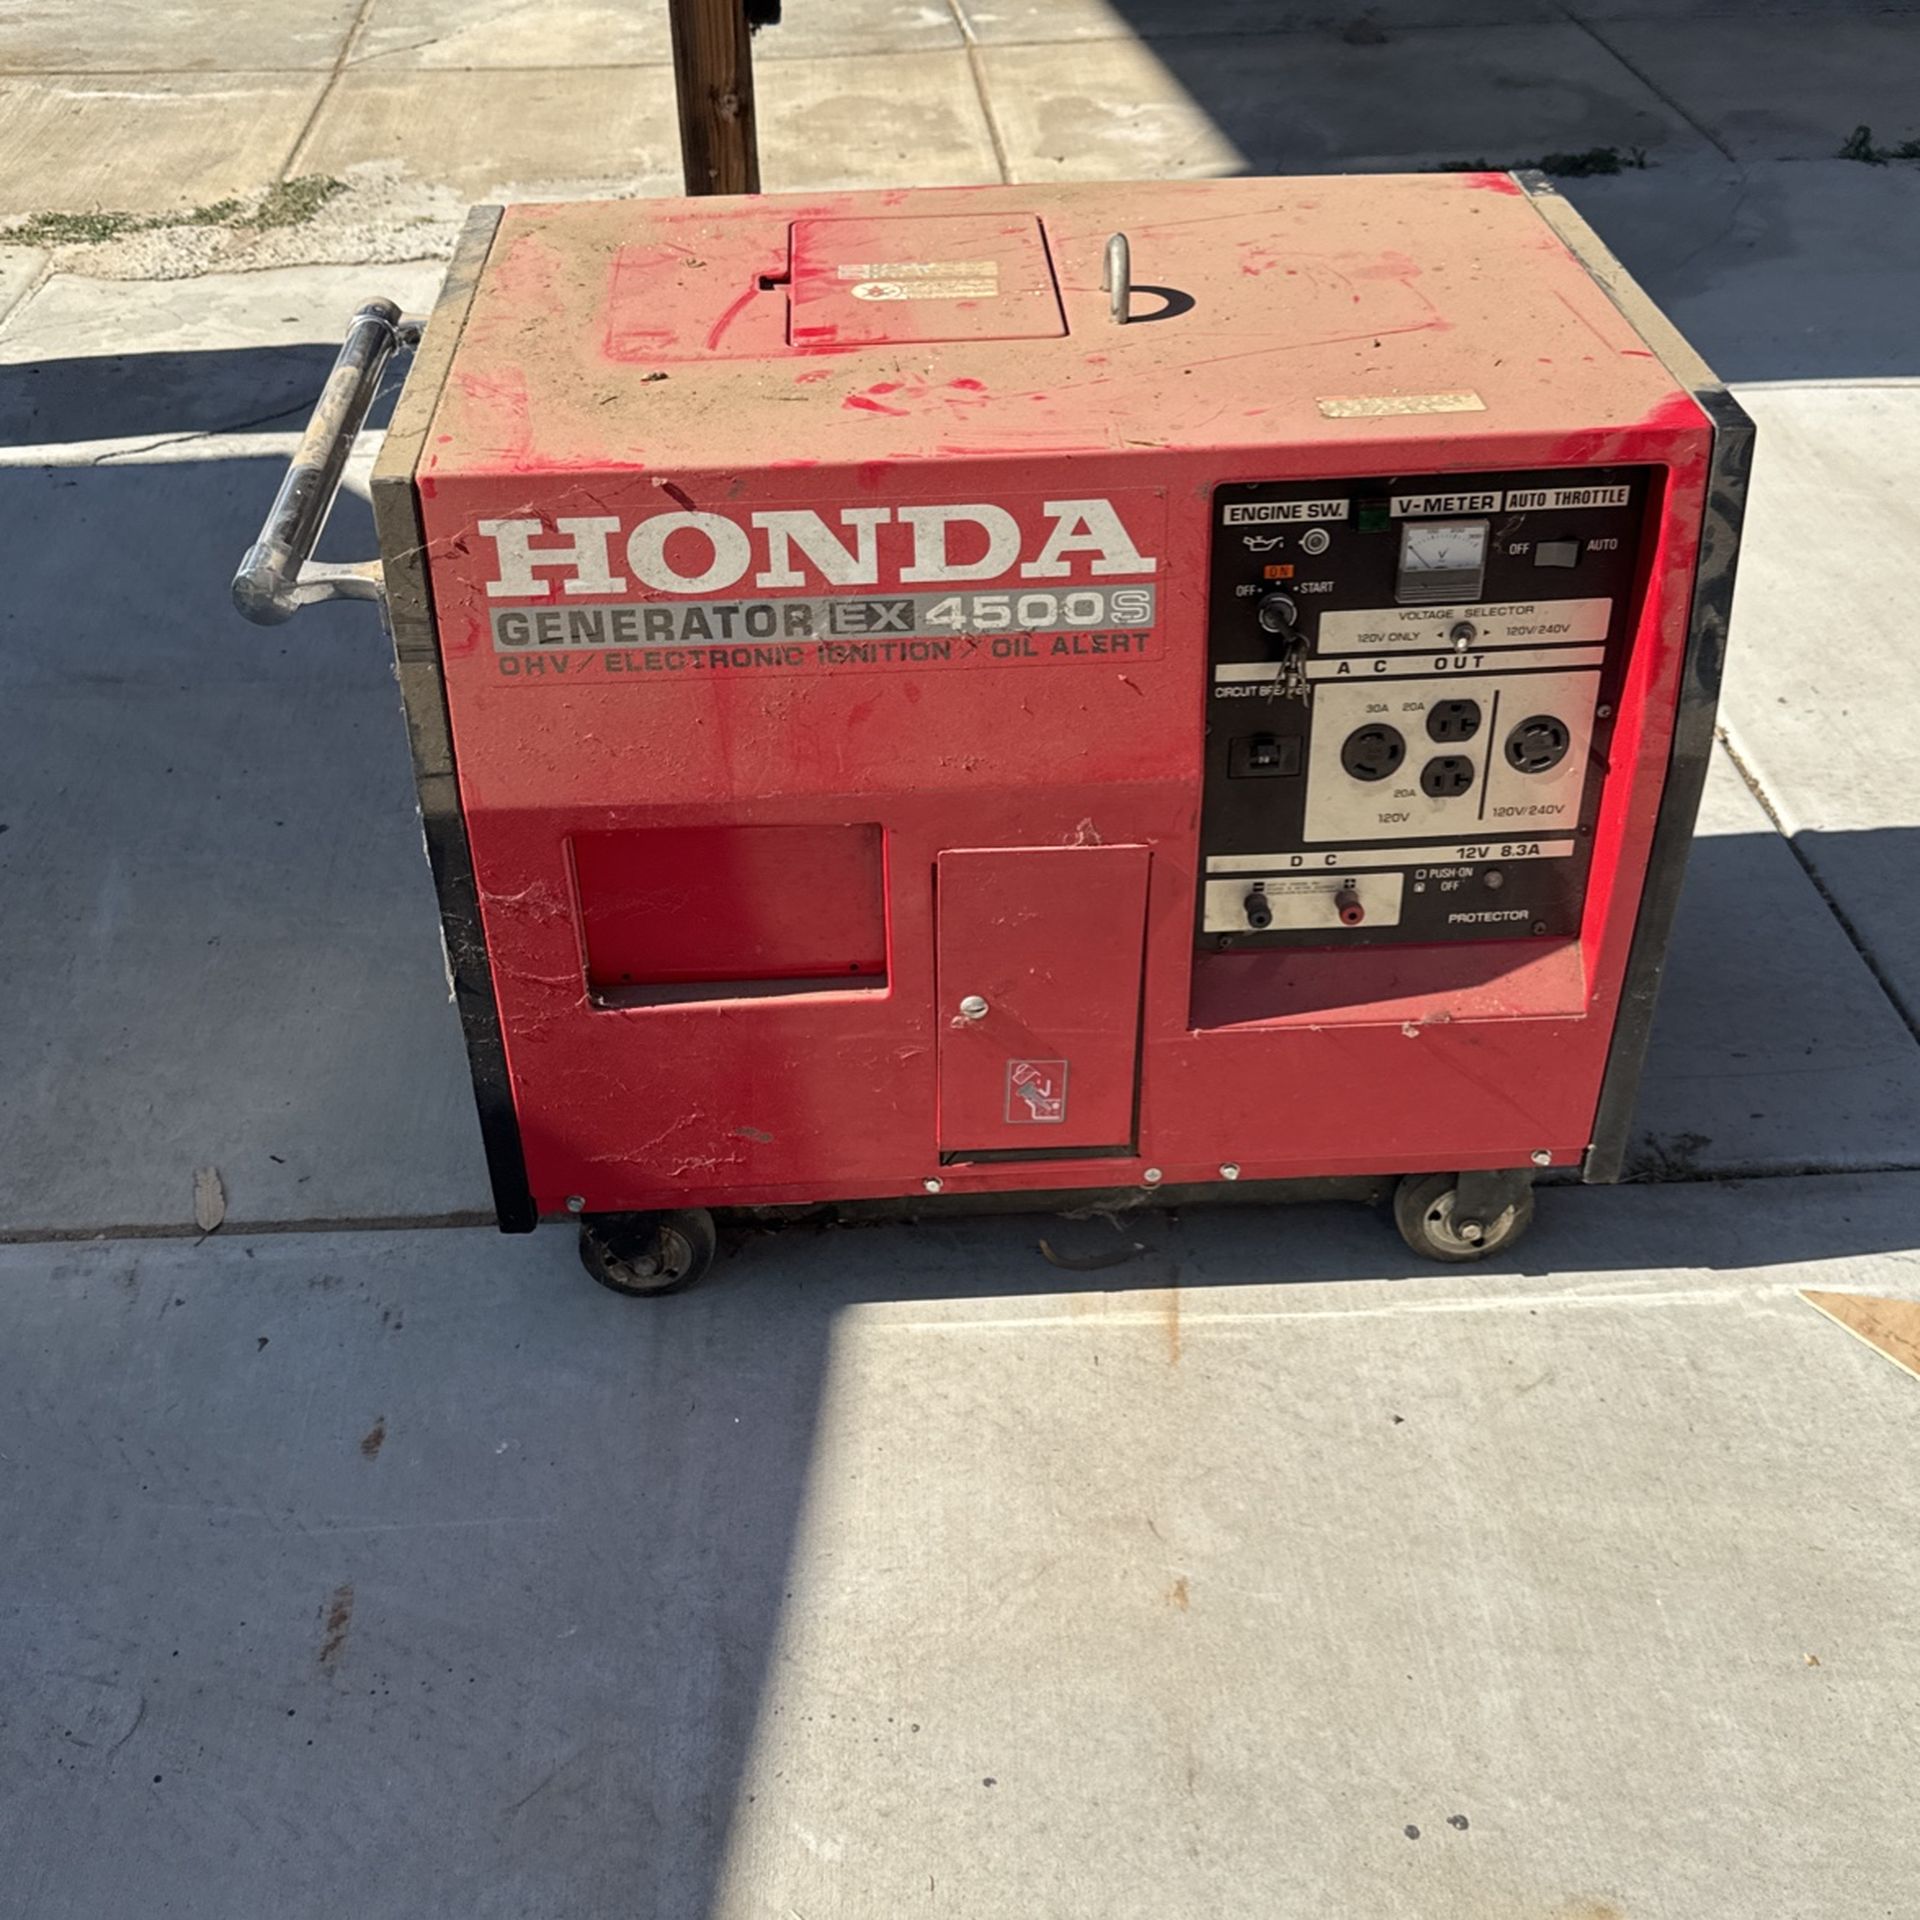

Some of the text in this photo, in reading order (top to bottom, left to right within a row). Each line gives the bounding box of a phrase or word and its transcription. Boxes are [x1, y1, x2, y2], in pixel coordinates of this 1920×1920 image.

[1398, 495, 1495, 514] V-METER
[1508, 488, 1625, 508] AUTO THROTTLE
[1230, 502, 1343, 522] ENGINE SW.
[478, 499, 1158, 596] HONDA
[1509, 543, 1531, 556] OFF
[1586, 539, 1618, 551] AUTO
[1268, 566, 1290, 578] ON
[1235, 585, 1256, 597] OFF
[1300, 582, 1335, 594] START
[497, 590, 1151, 646] GENERATOR EX 4500S
[1399, 605, 1535, 621] VOLTAGE SELECTOR
[1506, 624, 1571, 636] 120V/240V
[1358, 632, 1421, 644] 120V ONLY
[500, 653, 570, 676] OHV
[604, 647, 804, 673] ELECTRONIC
[818, 641, 951, 665] IGNITION
[991, 637, 1039, 659] OIL
[1050, 633, 1150, 656] ALERT
[1215, 683, 1311, 698] CIRCUIT BREER
[1366, 704, 1389, 713] 30A
[1402, 702, 1425, 712] 20A
[1394, 788, 1417, 799] 20A
[1492, 804, 1566, 818] 120V/240V
[1378, 812, 1411, 824] 120V
[1456, 844, 1540, 859] 12V 8.3A
[1441, 881, 1460, 891] OFF
[1448, 909, 1530, 923] PROTECTOR
